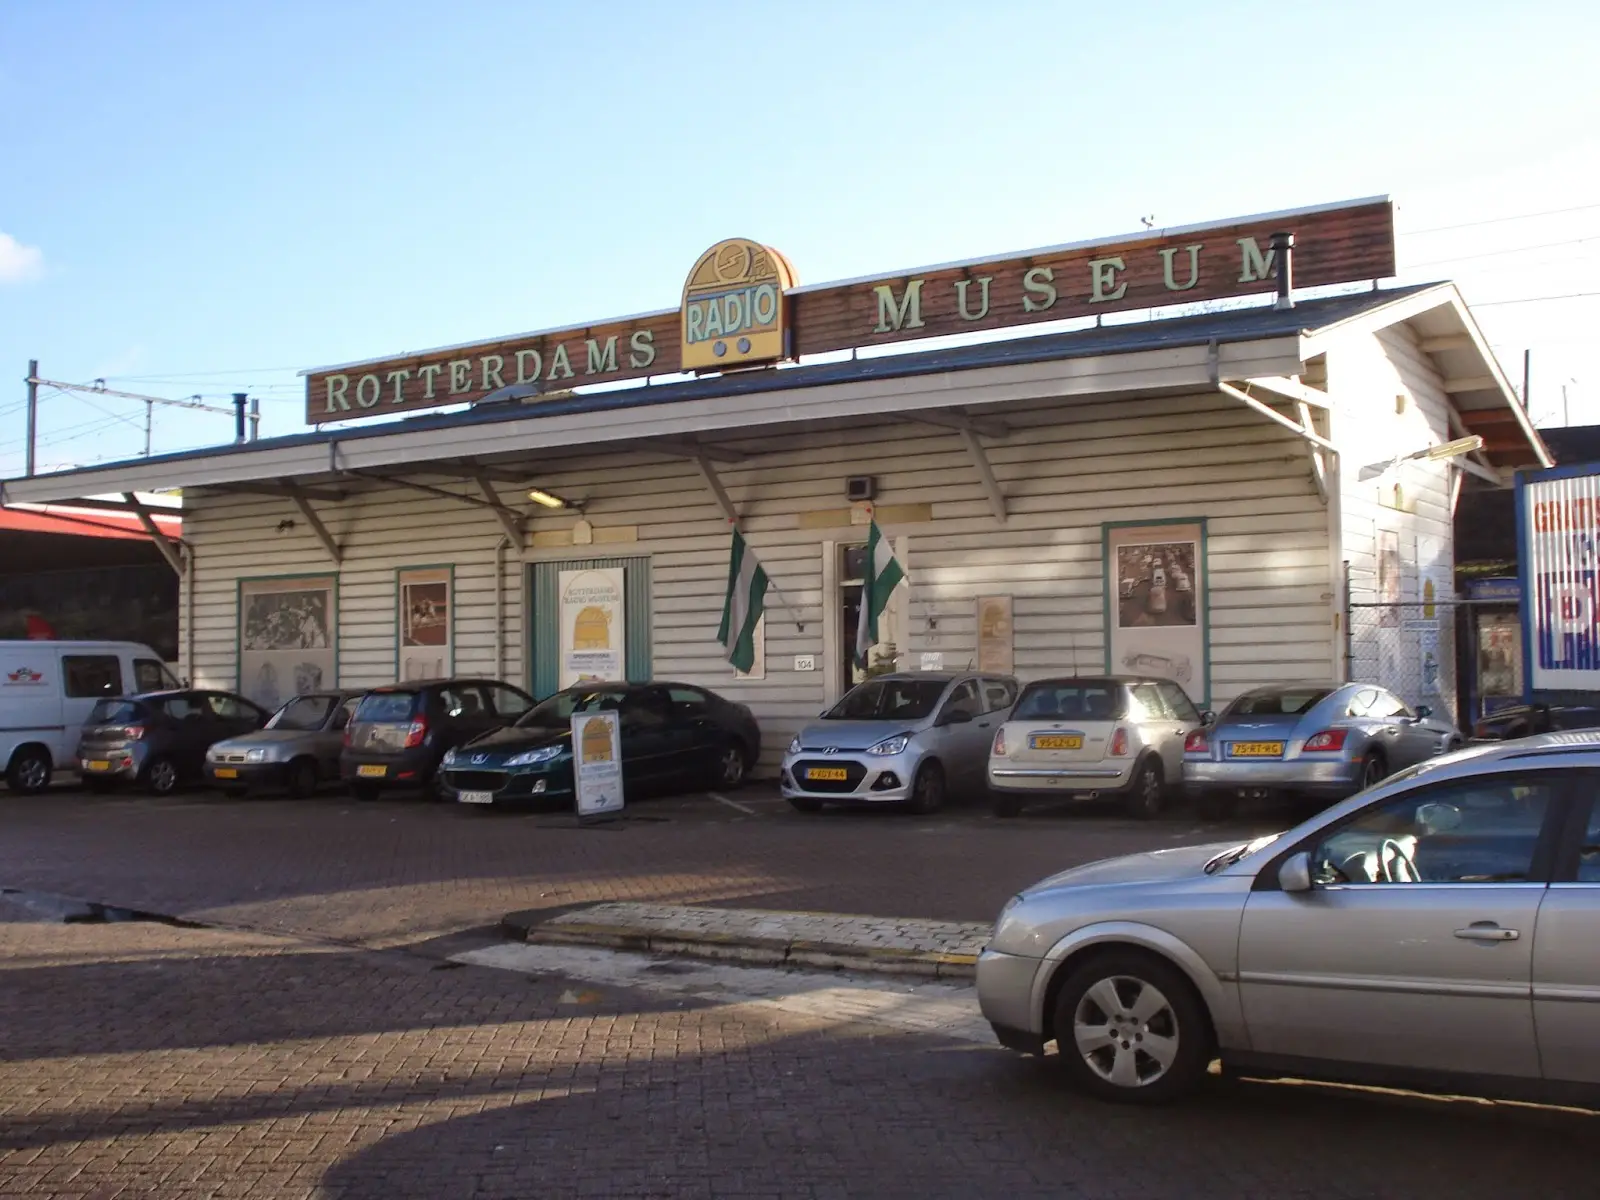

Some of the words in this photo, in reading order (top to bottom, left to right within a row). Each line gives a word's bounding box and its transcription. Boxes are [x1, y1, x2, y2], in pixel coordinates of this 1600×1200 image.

[323, 329, 657, 413] ROTTERDAMS
[686, 284, 778, 344] RADIO
[873, 236, 1278, 334] MUSEUM
[797, 660, 812, 669] 104
